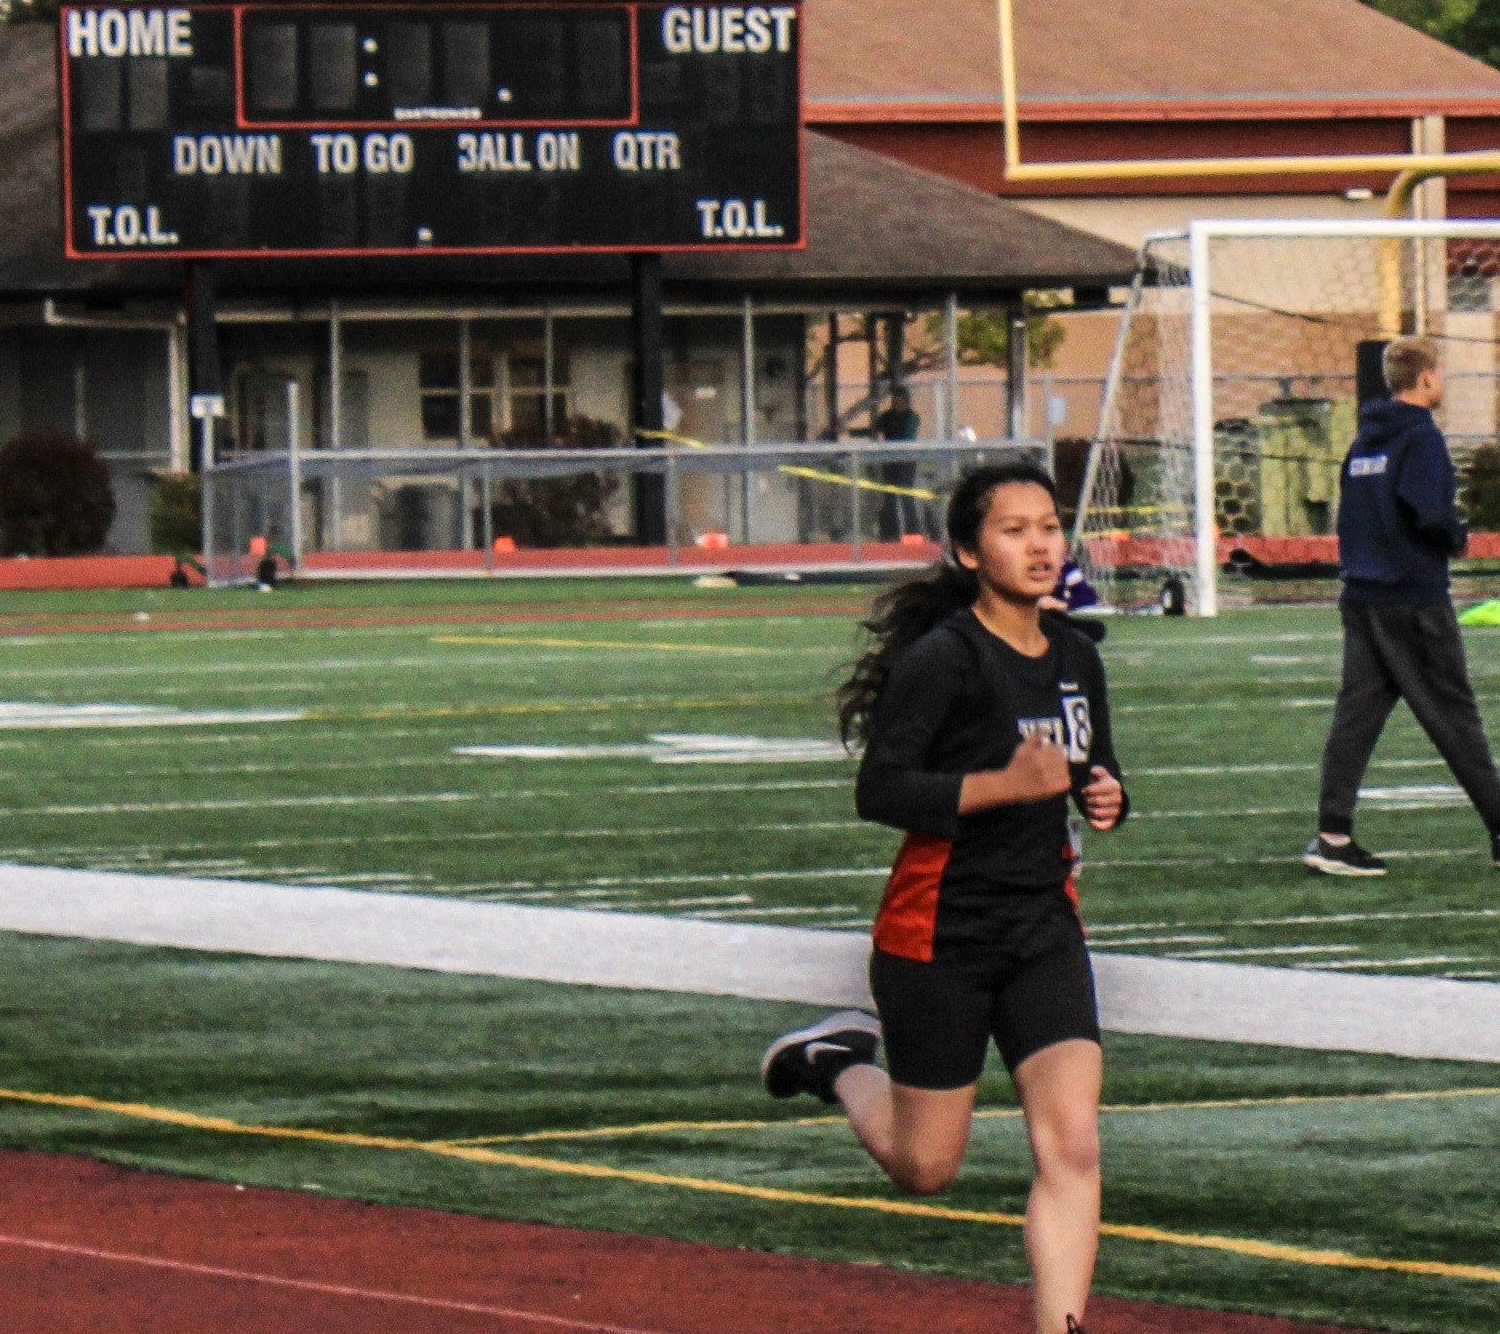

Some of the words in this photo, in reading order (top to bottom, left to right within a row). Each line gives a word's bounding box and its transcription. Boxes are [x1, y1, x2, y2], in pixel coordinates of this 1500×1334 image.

[68, 8, 194, 58] HOME
[662, 5, 797, 53] GUEST
[173, 134, 282, 175] DOWN
[310, 133, 358, 174] TO
[364, 133, 414, 174] GO
[536, 132, 580, 171] ON
[612, 131, 682, 172] QTR
[87, 205, 179, 245] T.O.L.
[696, 197, 785, 238] T.O.L.
[1071, 701, 1090, 752] 8
